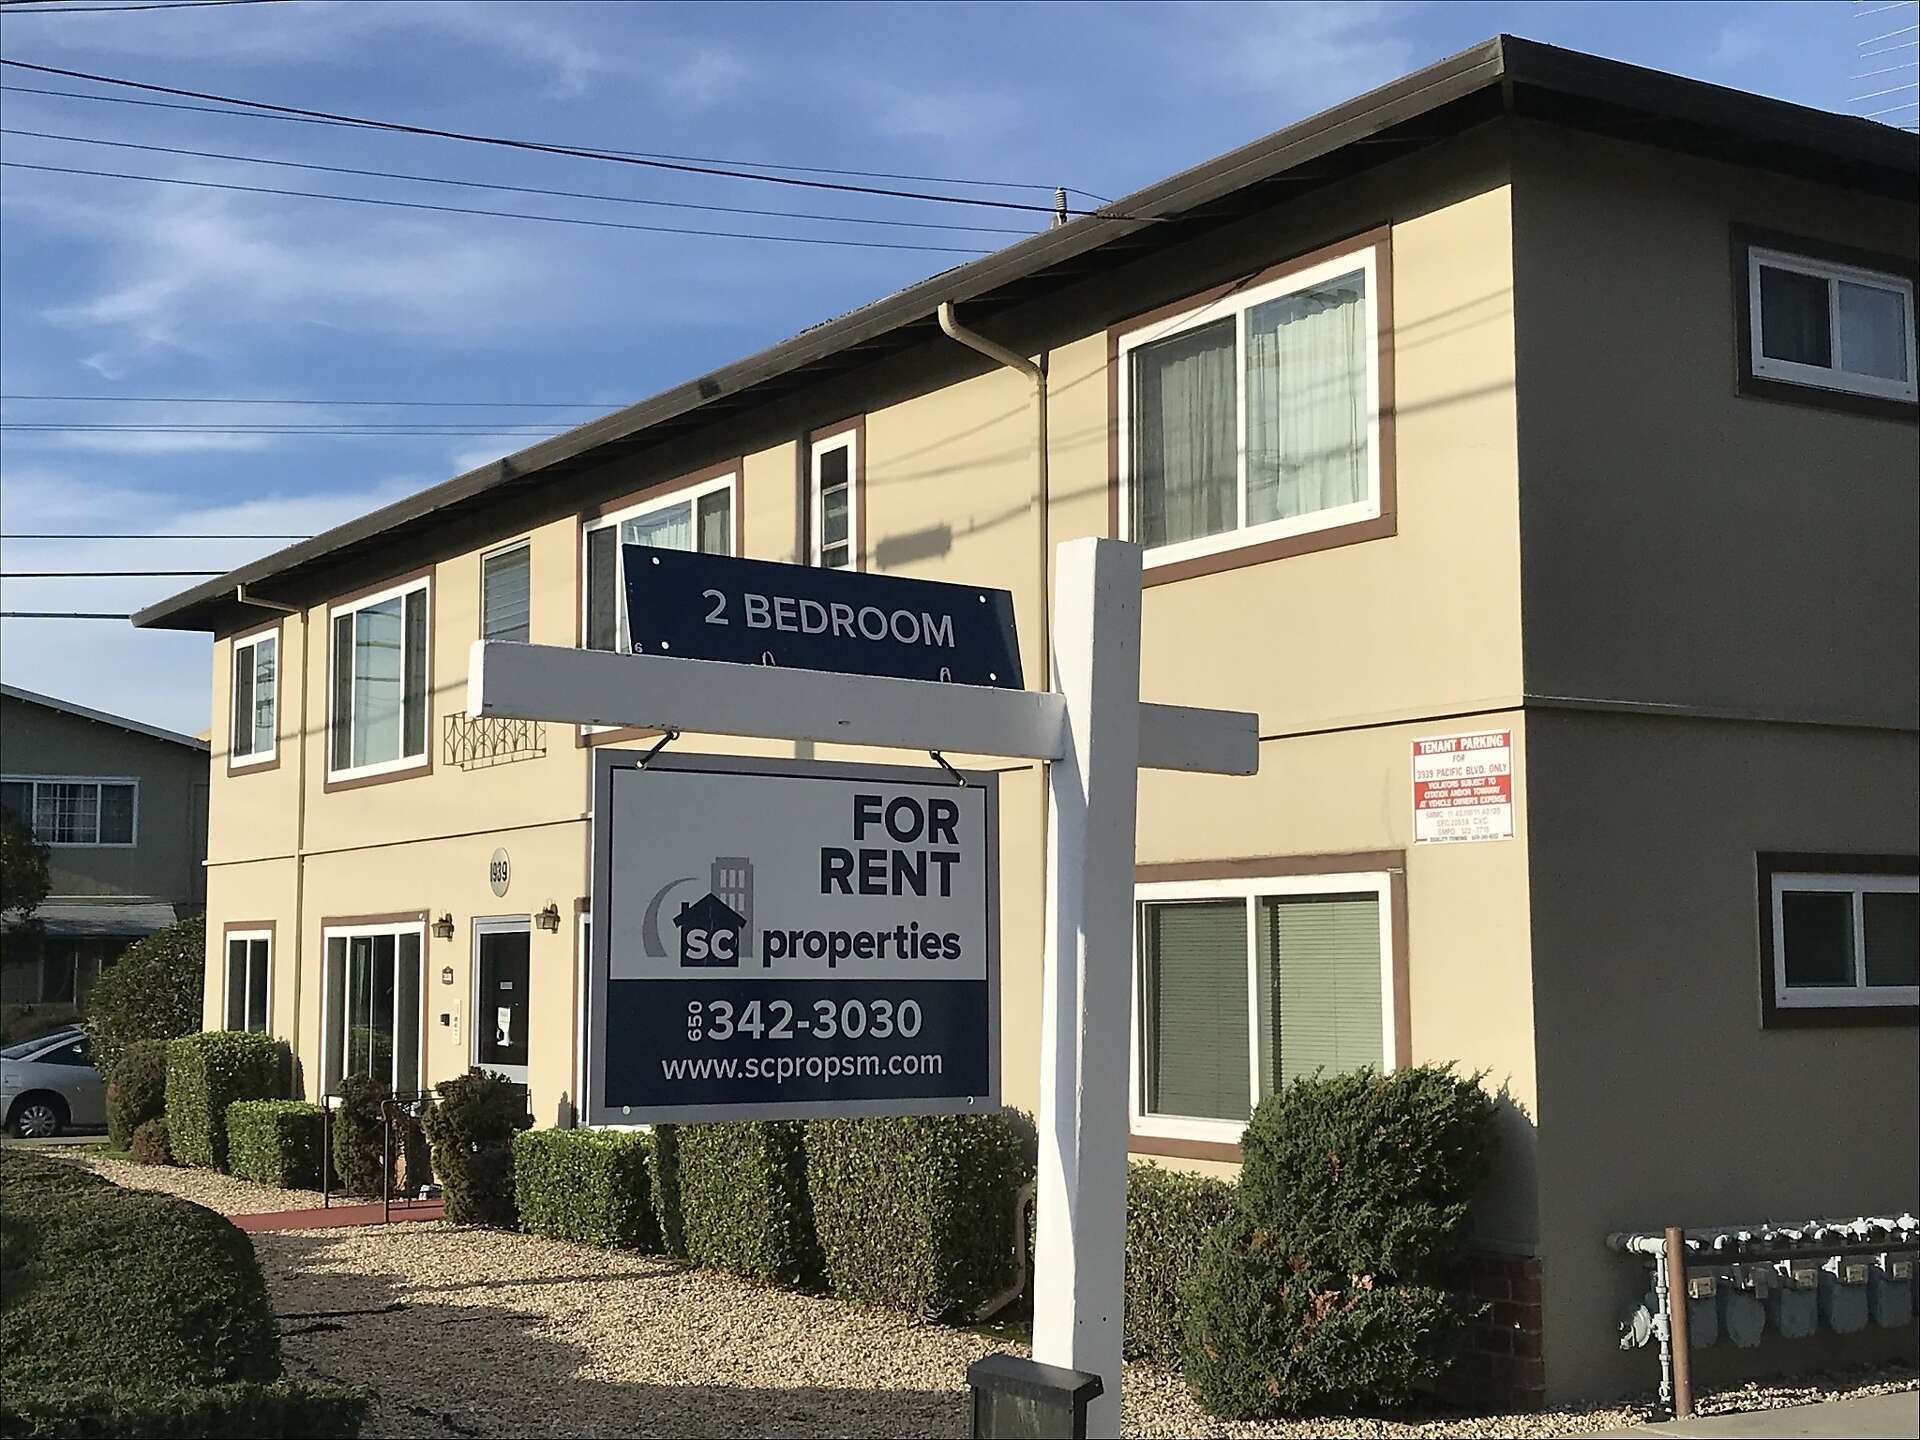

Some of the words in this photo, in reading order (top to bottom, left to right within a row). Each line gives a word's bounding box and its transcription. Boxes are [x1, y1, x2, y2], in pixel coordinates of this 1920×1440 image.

[701, 589, 729, 625] 2
[744, 592, 956, 648] BEDROOM
[634, 642, 643, 653] 6
[1419, 740, 1457, 754] TENANT
[1460, 734, 1504, 751] PARKING
[1452, 754, 1465, 763] FOR
[1428, 780, 1459, 790] VIOLATORS
[1460, 778, 1485, 788] SUBJECT
[1488, 777, 1497, 786] TO
[1436, 767, 1463, 778] PACIFIC
[1465, 765, 1486, 775] BLVD.
[1489, 763, 1507, 773] ONLY
[1419, 800, 1426, 809] AT
[1428, 798, 1452, 808] VEHICLE
[853, 794, 960, 845] FOR
[820, 847, 961, 897] RENT
[685, 928, 735, 960] SC
[762, 921, 962, 968] properties
[687, 1000, 703, 1042] 650
[707, 998, 922, 1041] 342-3030
[661, 1053, 943, 1084] www.scpropsm.com
